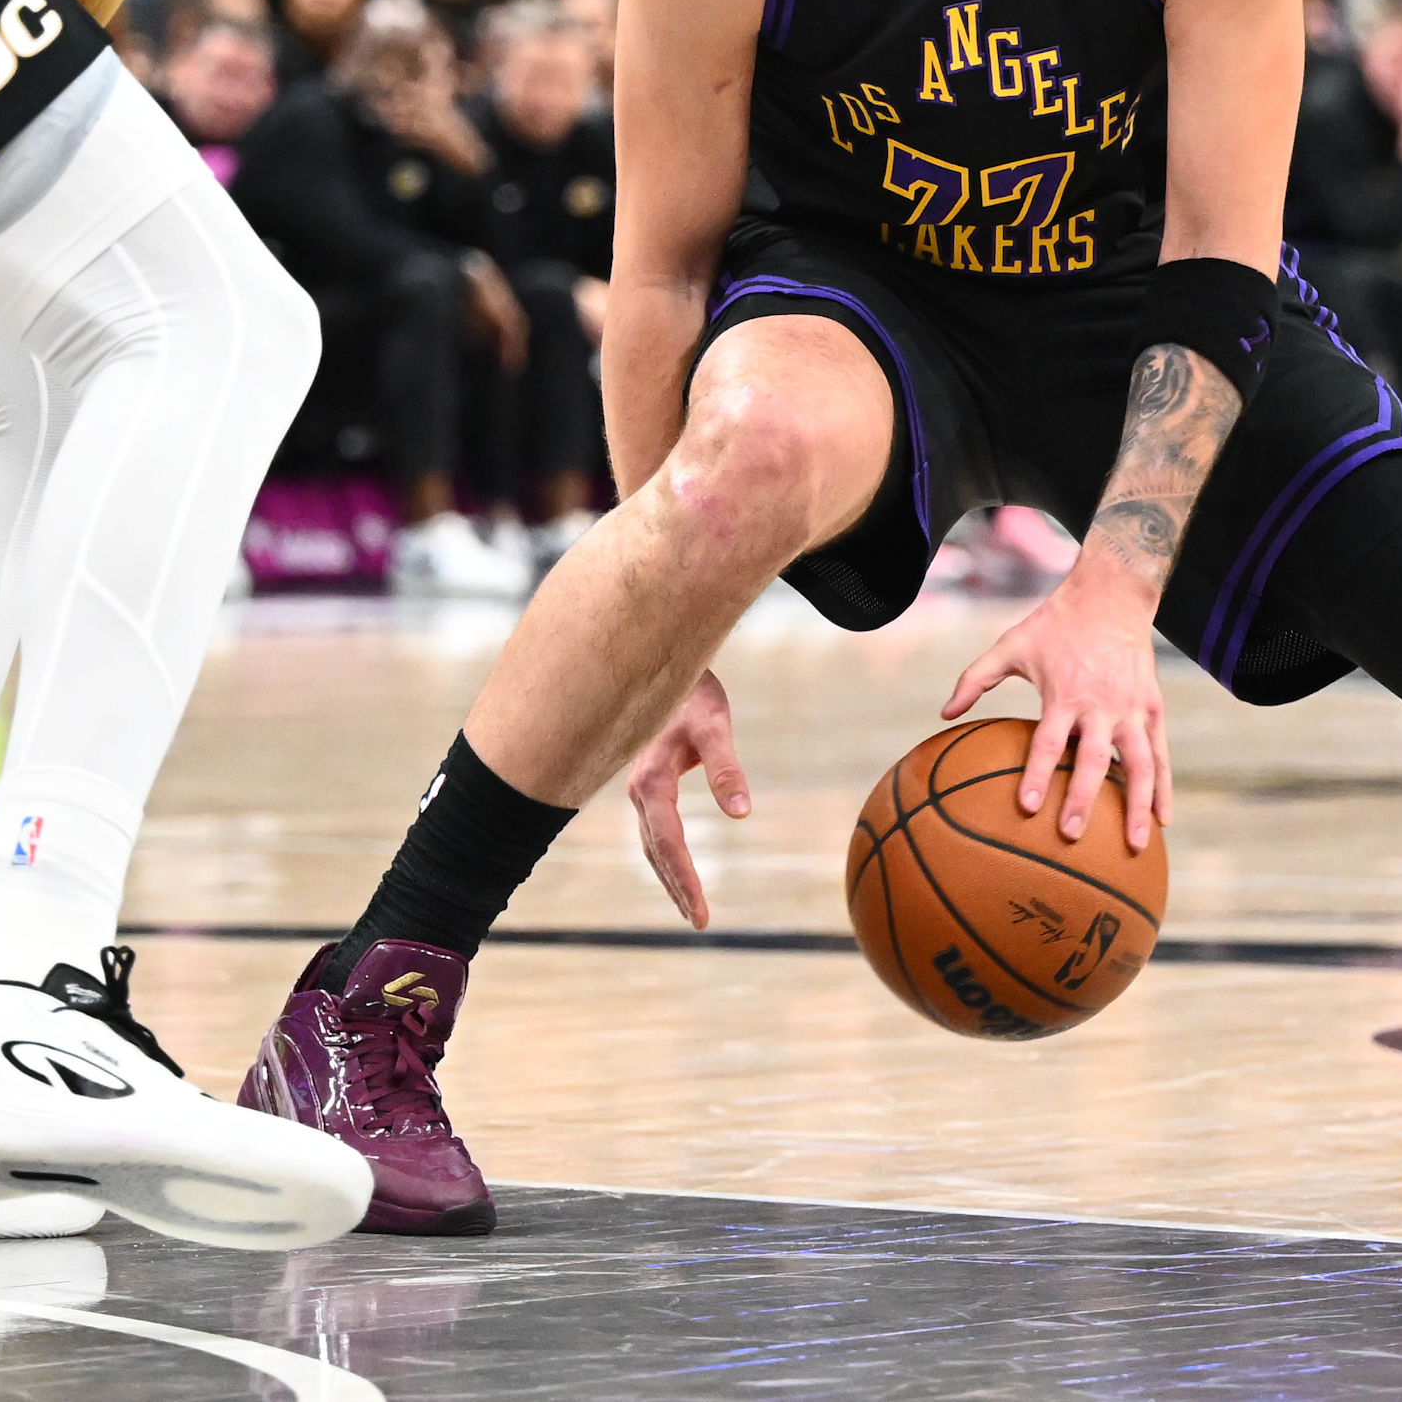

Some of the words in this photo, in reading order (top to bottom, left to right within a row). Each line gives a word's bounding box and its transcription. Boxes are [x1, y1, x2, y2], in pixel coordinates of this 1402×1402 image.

[821, 83, 901, 153] LOS
[914, 0, 1142, 156] ANGELES
[882, 137, 1076, 227] 77
